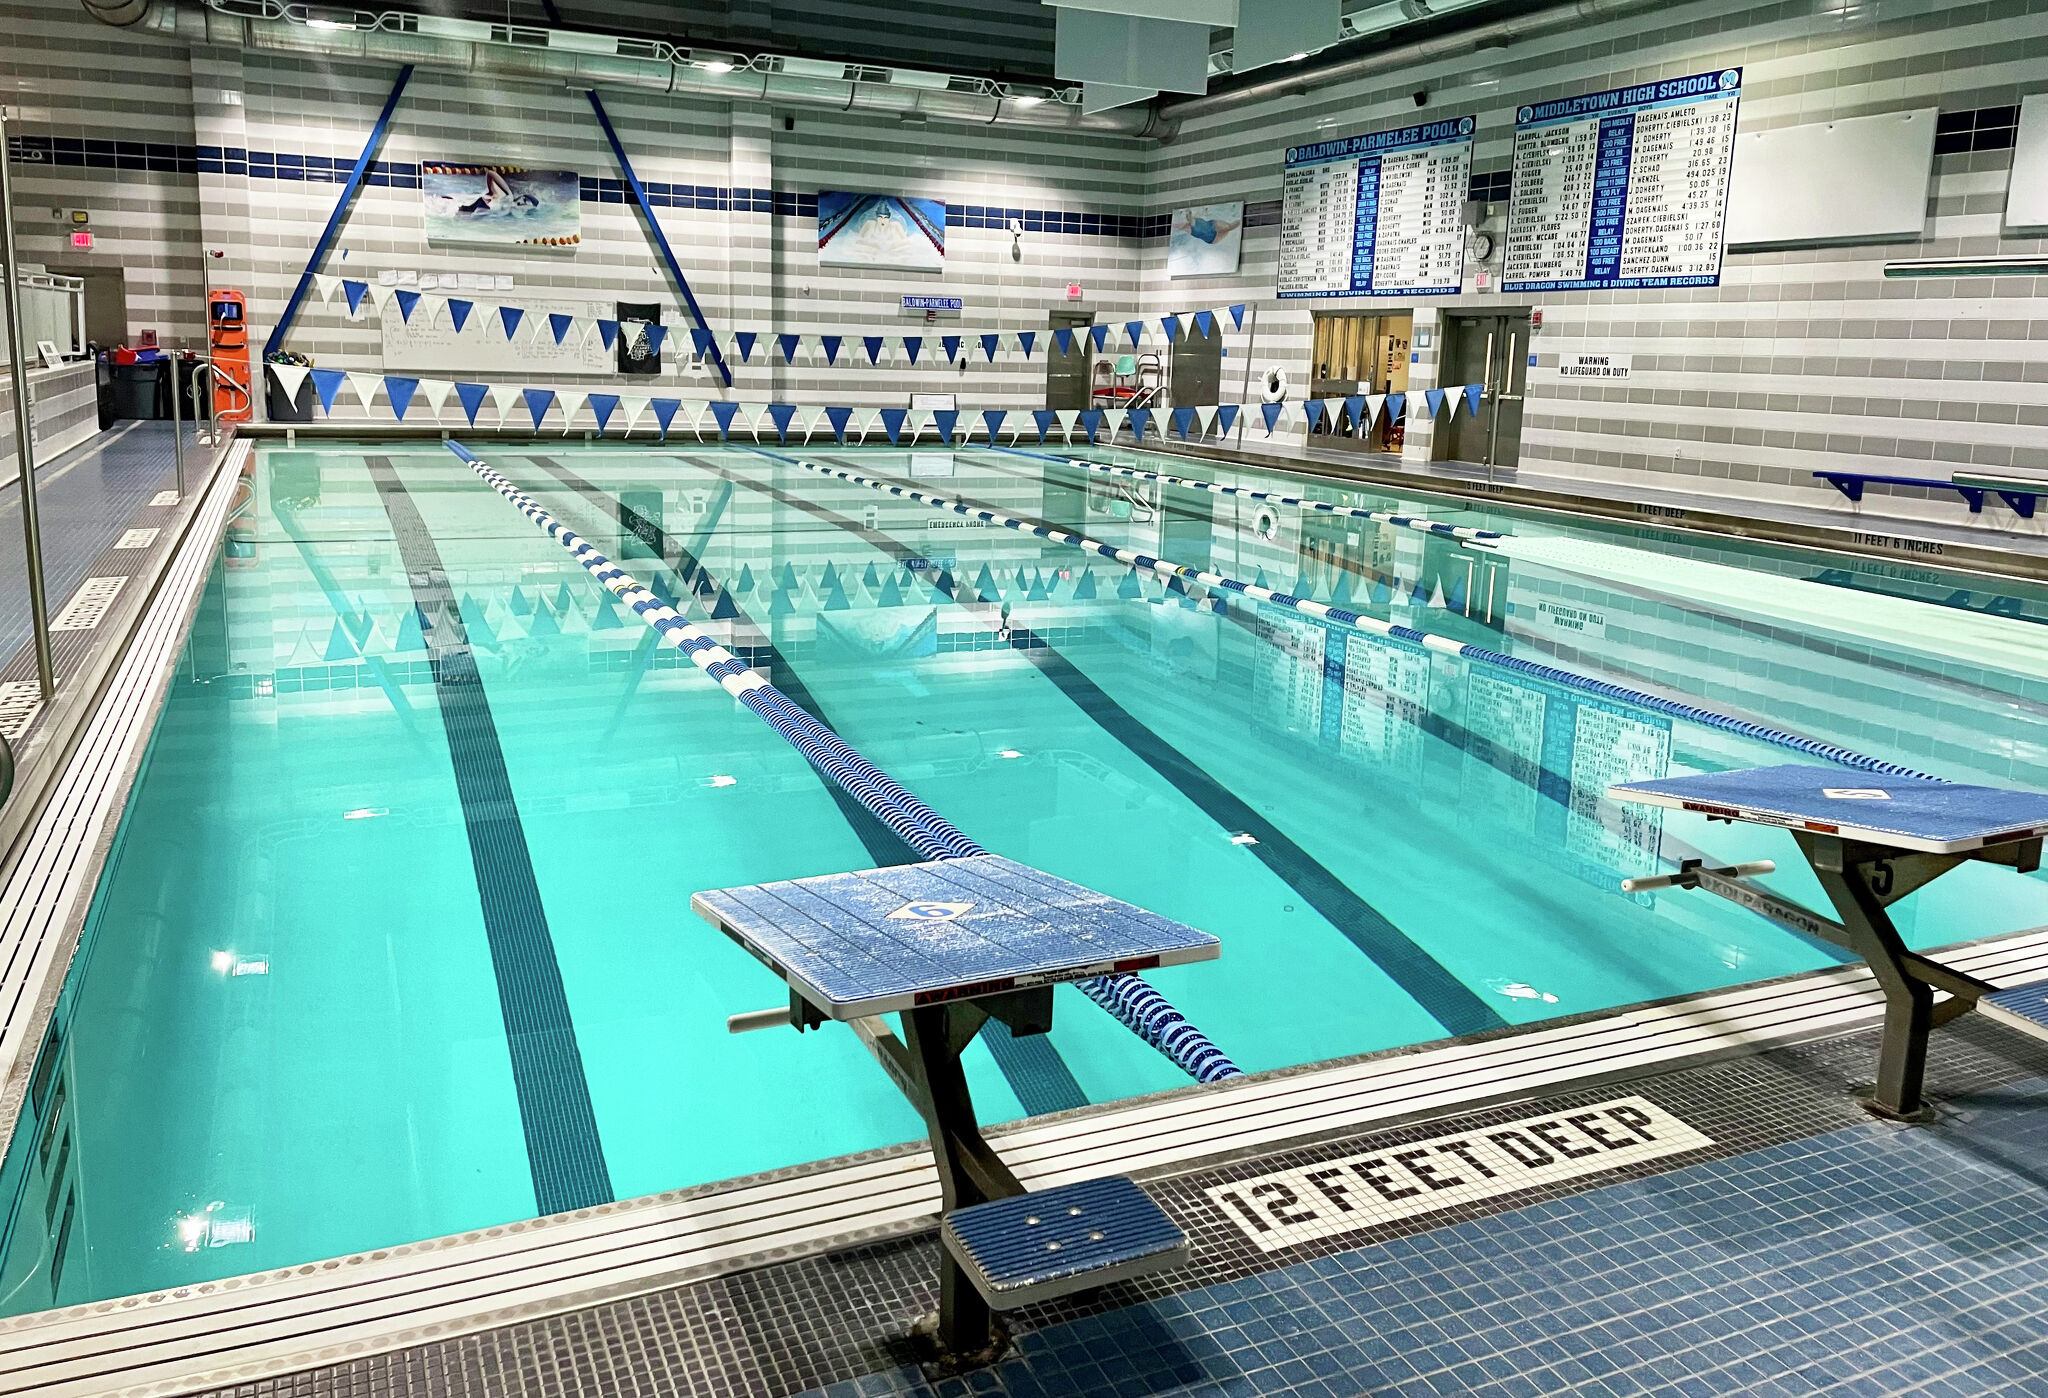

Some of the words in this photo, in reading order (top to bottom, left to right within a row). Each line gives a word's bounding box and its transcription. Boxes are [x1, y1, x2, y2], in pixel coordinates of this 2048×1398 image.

[1535, 92, 1619, 119] MIDDLETOWN
[1623, 86, 1655, 104] HIGH
[1659, 76, 1716, 98] SCHOOL
[1671, 108, 1695, 118] AMLETO
[1298, 128, 1420, 160] BALDWIN-PARMELEE
[1423, 122, 1457, 139] POOL
[1643, 132, 1670, 142] DOHERTY
[1643, 142, 1673, 152] DAGENAIS
[1641, 153, 1668, 163] DOHERTY
[1636, 185, 1664, 193] DOHERTY
[1636, 195, 1663, 203] DOHERTY
[1636, 205, 1668, 213] DAGENAIS
[1631, 245, 1668, 254] STRICKLAND
[1652, 265, 1682, 273] DAGENAIS
[1476, 274, 1486, 286] EXIT
[1611, 278, 1640, 286] DIVING
[1642, 278, 1667, 286] TEAM
[1670, 276, 1714, 285] RECORDS
[1579, 357, 1609, 365] WARNING
[1570, 367, 1600, 375] LIFEGUARD
[1603, 368, 1610, 376] ON
[1613, 368, 1628, 376] DUTY
[1865, 534, 1890, 547] FEET
[1894, 538, 1900, 548] 6
[1904, 539, 1943, 554] INCHES
[1871, 859, 1894, 896] 5
[908, 905, 954, 917] 6
[1221, 1181, 1317, 1233] 12
[1305, 1139, 1500, 1212] FEET
[1487, 1105, 1658, 1168] DEEP
